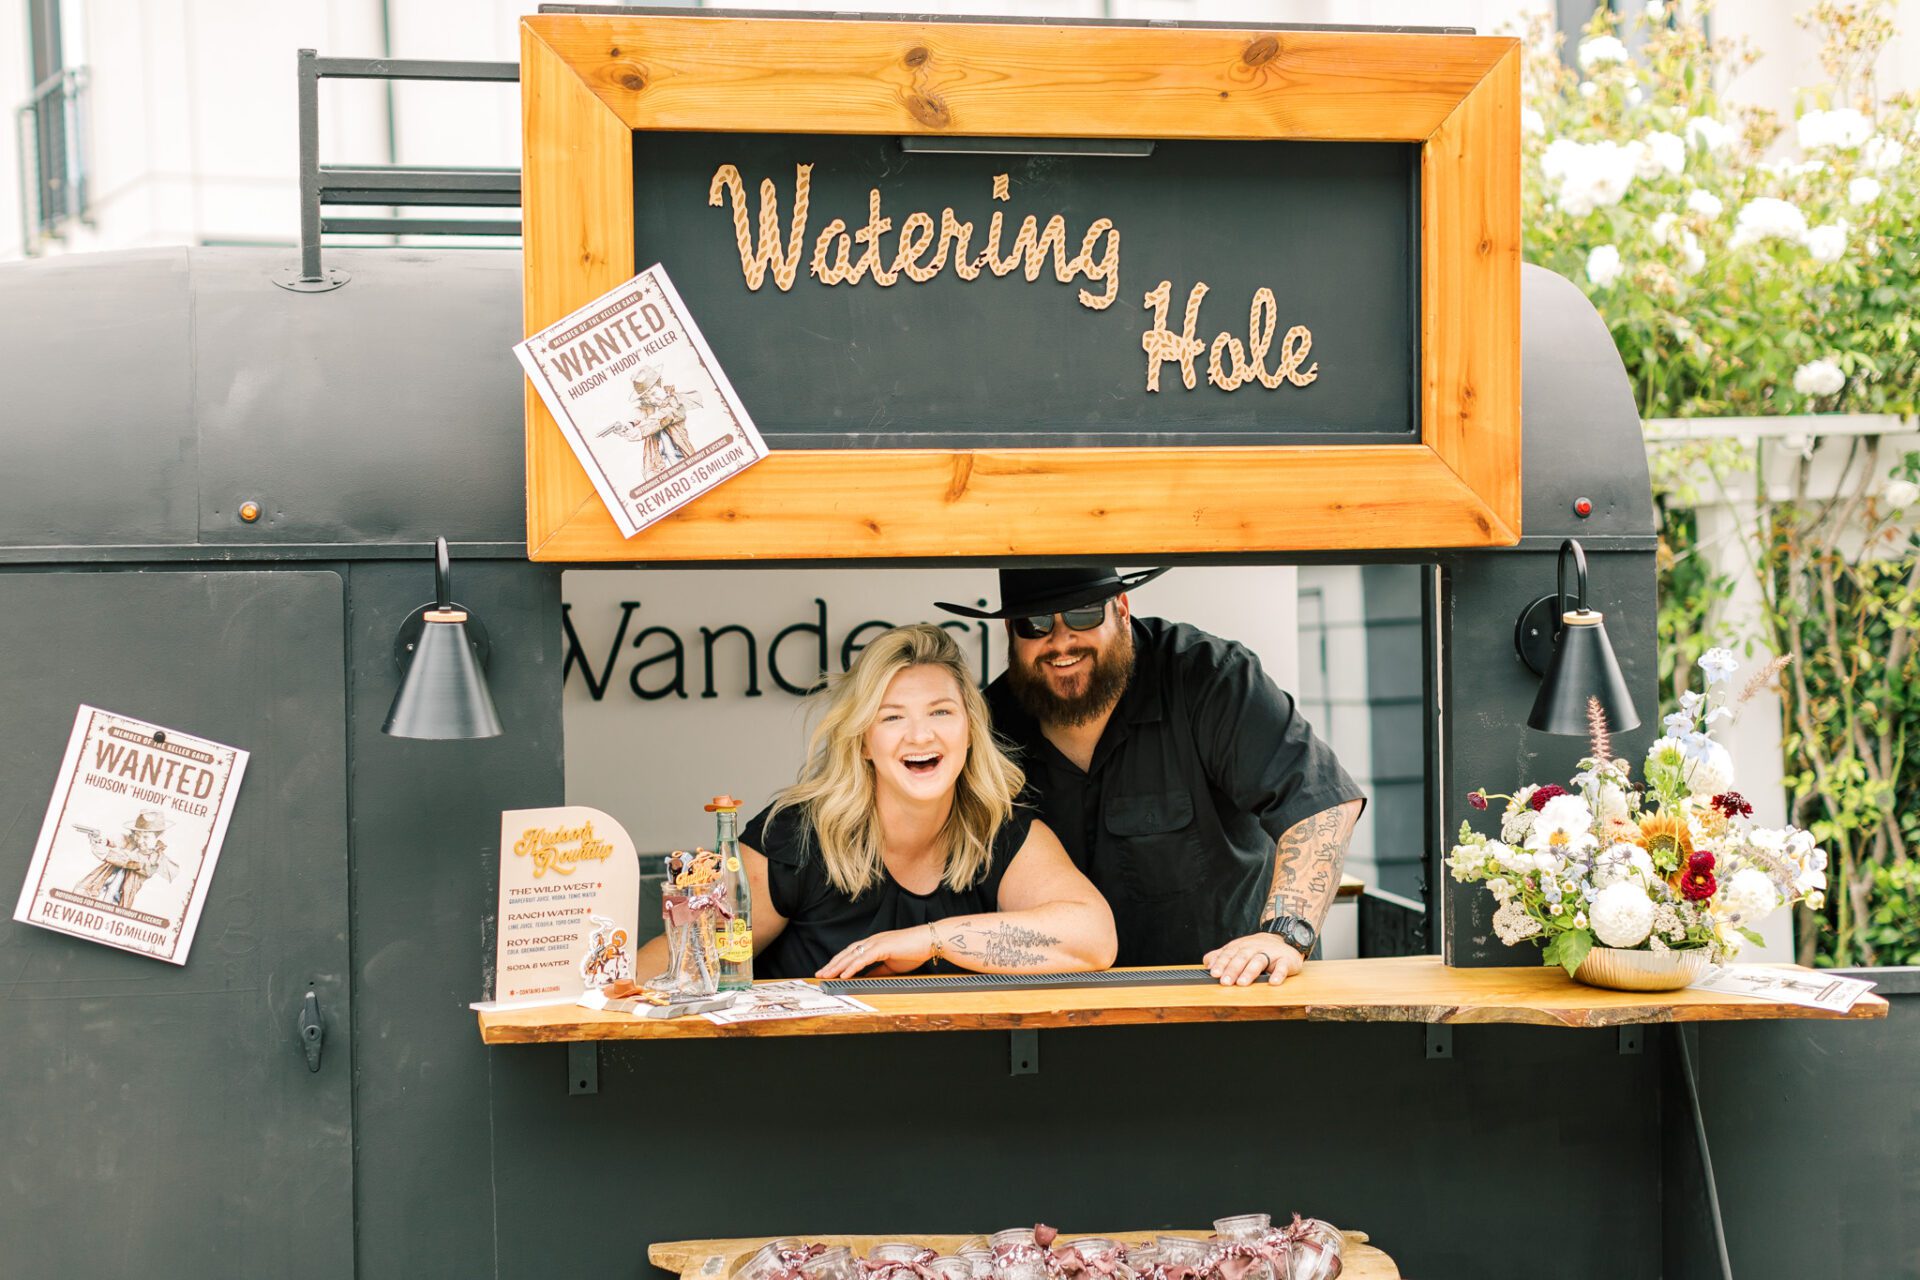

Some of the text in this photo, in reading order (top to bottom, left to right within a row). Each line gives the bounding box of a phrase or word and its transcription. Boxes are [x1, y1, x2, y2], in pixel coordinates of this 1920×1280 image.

[709, 163, 1120, 309] Watering
[551, 303, 666, 382] WANTED
[552, 292, 639, 347] MEMBER OF THE KELLER GANG
[1142, 281, 1318, 392] Hole
[567, 329, 678, 400] HUDSON "HUDDY" KELLER
[635, 476, 691, 517] REWARD
[705, 445, 744, 475] MILLION
[112, 728, 209, 761] MEMBER OF THE KELLER GANG
[95, 739, 215, 800] WANTED
[84, 772, 208, 818] HUDSON "HUDDY" KELLER
[514, 820, 593, 858] Hudson's
[509, 882, 595, 896] THE WILD WEST
[42, 901, 104, 931] REWARD
[122, 925, 166, 947] MILLION
[508, 908, 584, 920] RANCH WATER
[507, 934, 578, 947] ROY ROGERS
[540, 960, 570, 968] WATER
